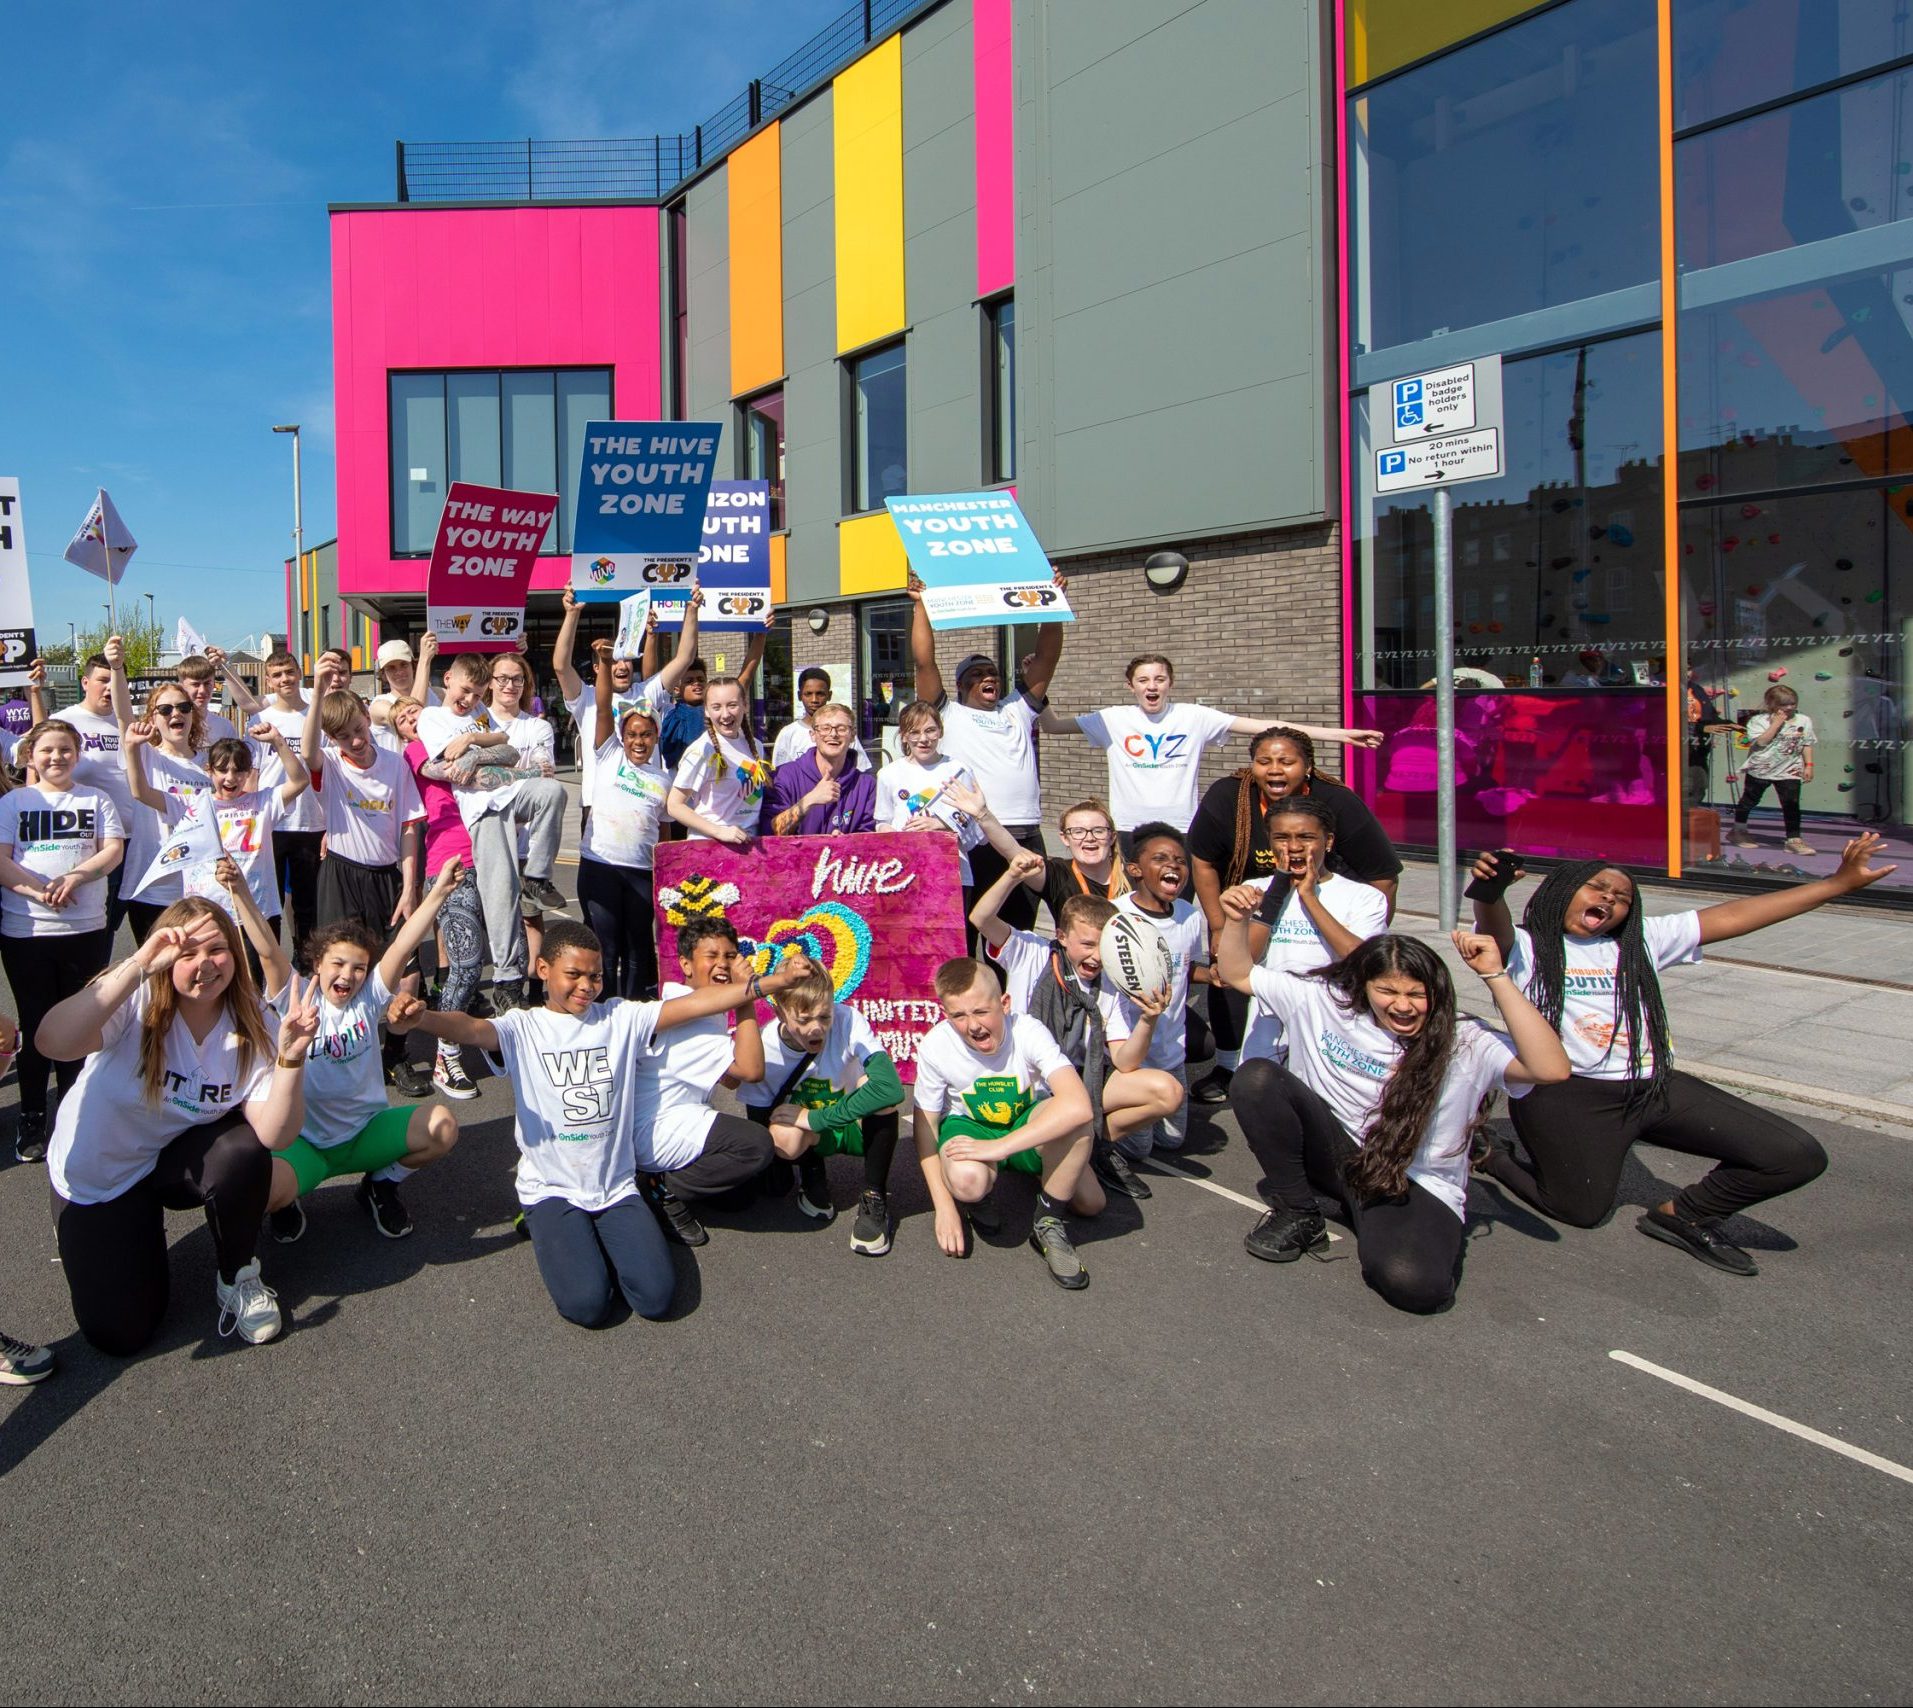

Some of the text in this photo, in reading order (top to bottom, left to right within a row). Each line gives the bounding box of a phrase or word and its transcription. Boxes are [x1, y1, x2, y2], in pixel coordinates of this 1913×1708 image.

[1425, 374, 1470, 390] Disabled
[1402, 382, 1418, 401] P
[1429, 392, 1467, 406] holders
[1432, 385, 1463, 398] badge
[1436, 403, 1459, 413] only
[589, 436, 714, 455] THE HIVE
[1429, 438, 1470, 451] 20 mins
[1408, 443, 1493, 465] No return within
[1441, 457, 1465, 467] hour
[1386, 455, 1401, 473] P
[590, 462, 705, 485] YOUTH
[599, 493, 686, 515] ZONE
[707, 491, 766, 508] IZON
[892, 499, 1012, 514] MANCHESTER
[447, 501, 552, 528] THE WAY
[702, 515, 761, 535] UTH
[903, 513, 1019, 535] YOUTH
[446, 526, 538, 552] YOUTH
[927, 537, 1018, 557] ZONE
[697, 545, 750, 563] ONE
[447, 555, 518, 578] ZONE
[642, 563, 691, 583] CUP
[718, 597, 765, 615] CUP
[1003, 590, 1058, 608] CUP
[0, 631, 25, 639] DENT'S
[481, 617, 519, 635] CUP
[6, 707, 30, 716] WYZ
[1125, 733, 1187, 760] CYZ
[19, 809, 95, 842] HIDE
[62, 843, 80, 851] Youth
[811, 846, 916, 900] hive
[1271, 927, 1321, 936] UTH ZONE
[1115, 935, 1142, 991] STEEDEN
[1565, 976, 1611, 989] OUTH
[1351, 1058, 1386, 1077] ZONE
[172, 1097, 200, 1114] OnSide
[559, 1132, 589, 1141] OnSide
